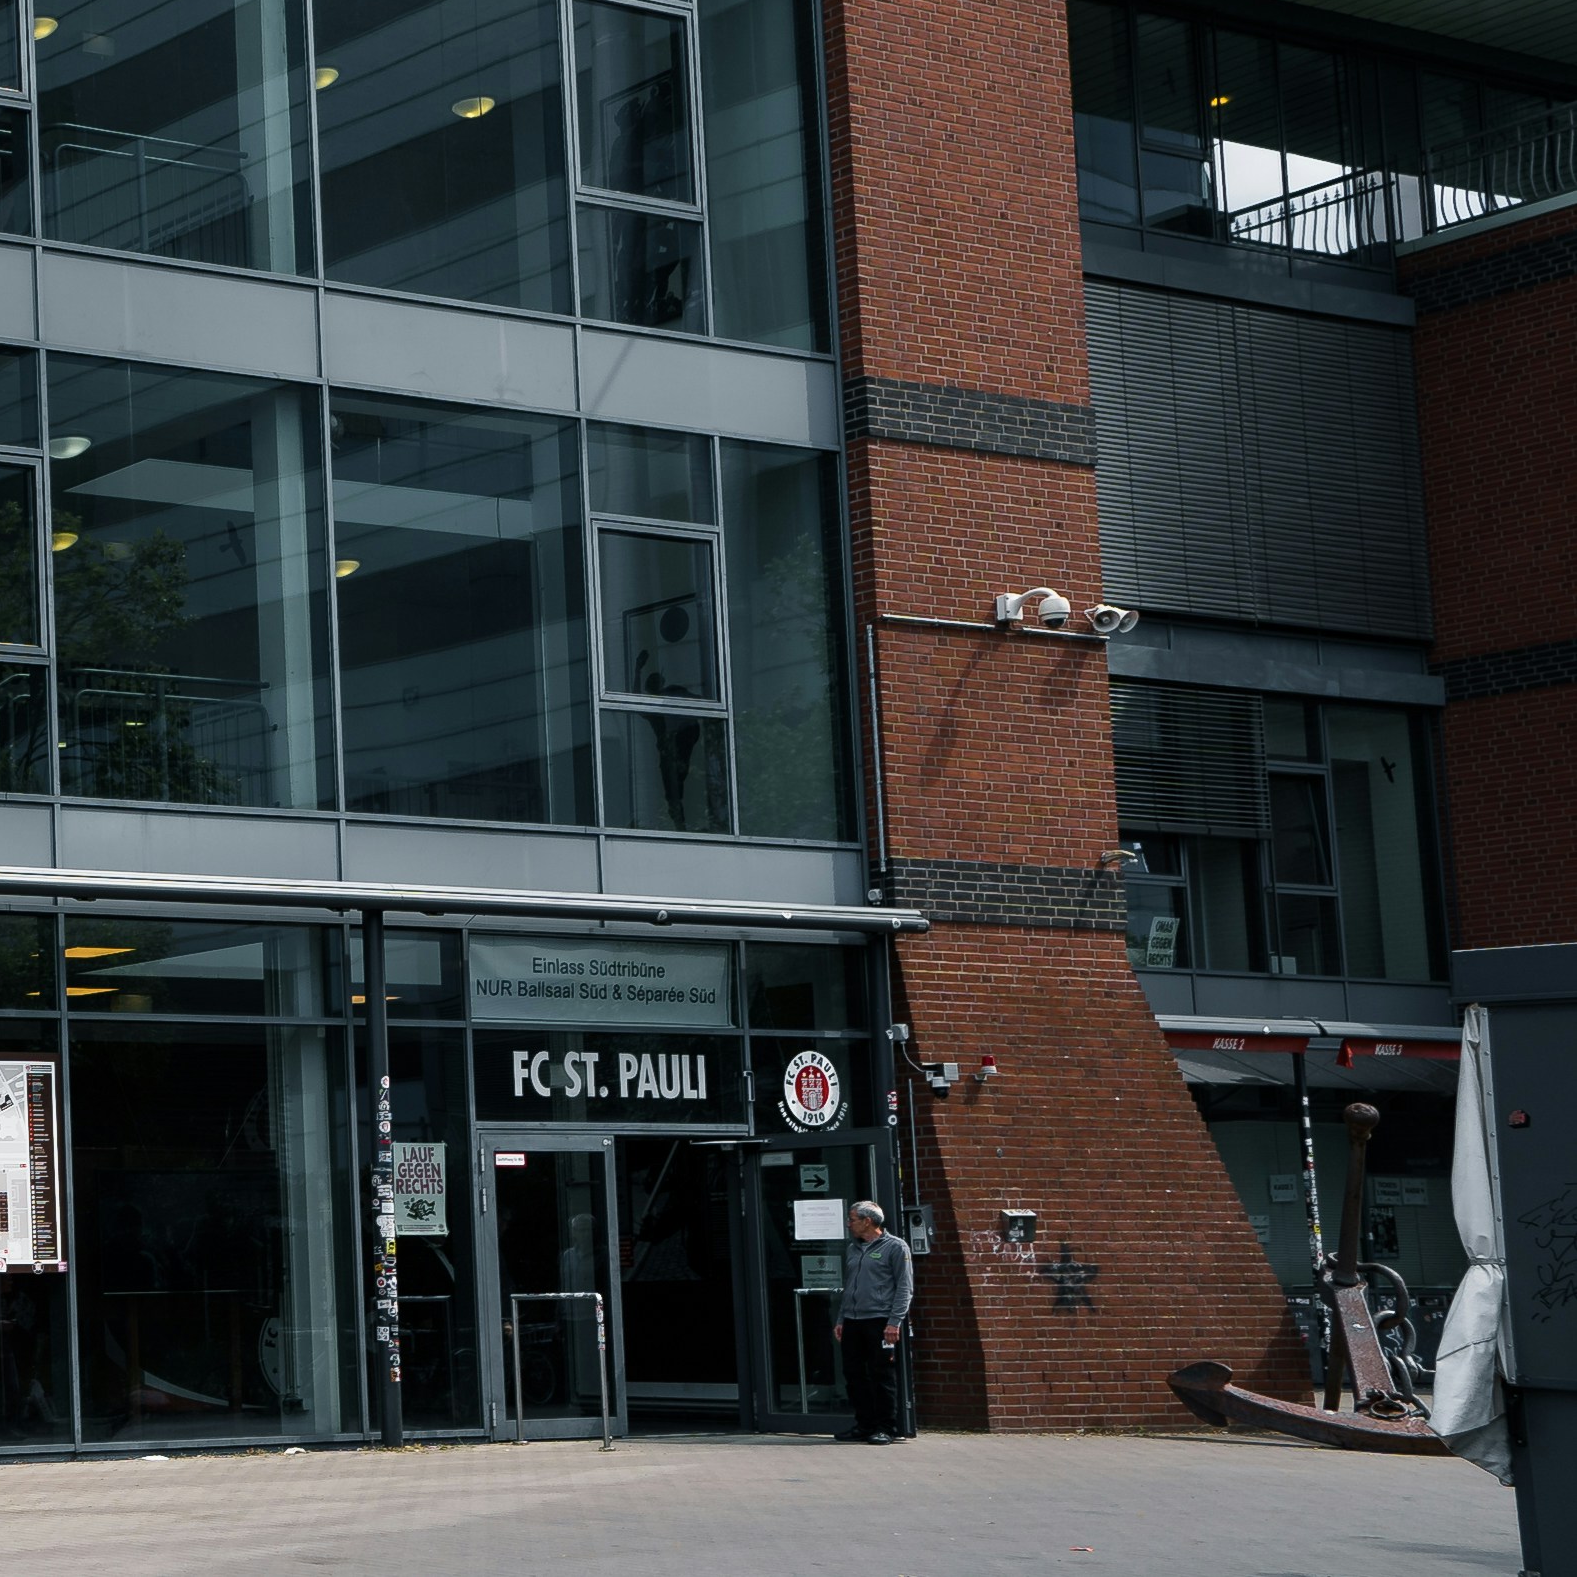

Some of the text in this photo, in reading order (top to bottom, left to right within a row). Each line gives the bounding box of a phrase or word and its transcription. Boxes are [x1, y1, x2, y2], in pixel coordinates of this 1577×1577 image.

[532, 957, 666, 979] Einlass Südtribüne
[476, 979, 716, 1005] NUR Ballsaal Süd & Séparée Süd
[1213, 1037, 1245, 1050] KASSE 2
[1375, 1043, 1403, 1056] KASSE 3
[512, 1050, 707, 1099] FC ST. PAULI
[785, 1070, 795, 1086] FC
[811, 1053, 838, 1086] PAULI
[802, 1111, 825, 1123] 1910
[402, 1146, 435, 1163] LAUF
[397, 1163, 442, 1179] GEGEN
[396, 1179, 444, 1195] RECHTS
